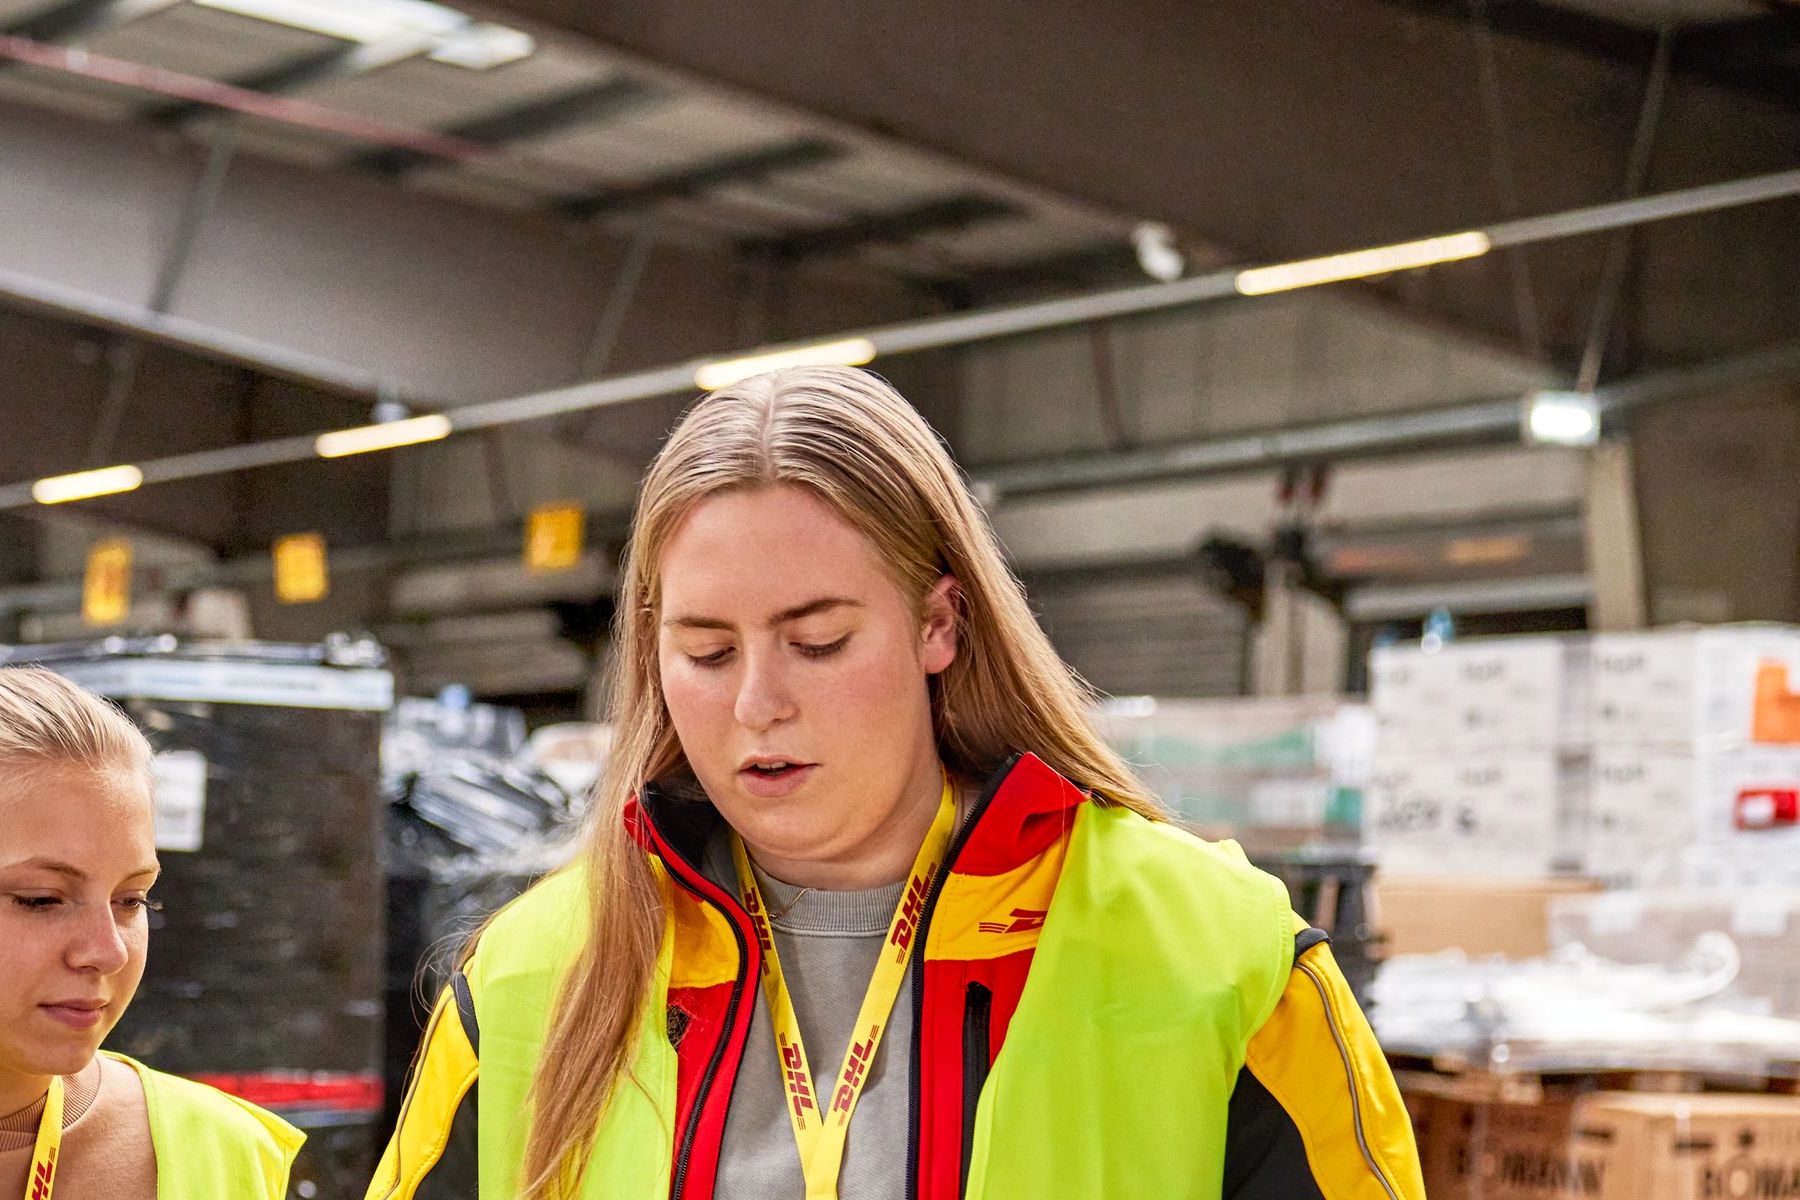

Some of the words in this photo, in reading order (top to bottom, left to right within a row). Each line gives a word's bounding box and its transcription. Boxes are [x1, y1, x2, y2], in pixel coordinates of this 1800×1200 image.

[743, 887, 772, 961] DHL
[890, 874, 931, 951] DHL
[782, 1043, 814, 1117] DHL
[832, 1038, 874, 1113] DHL
